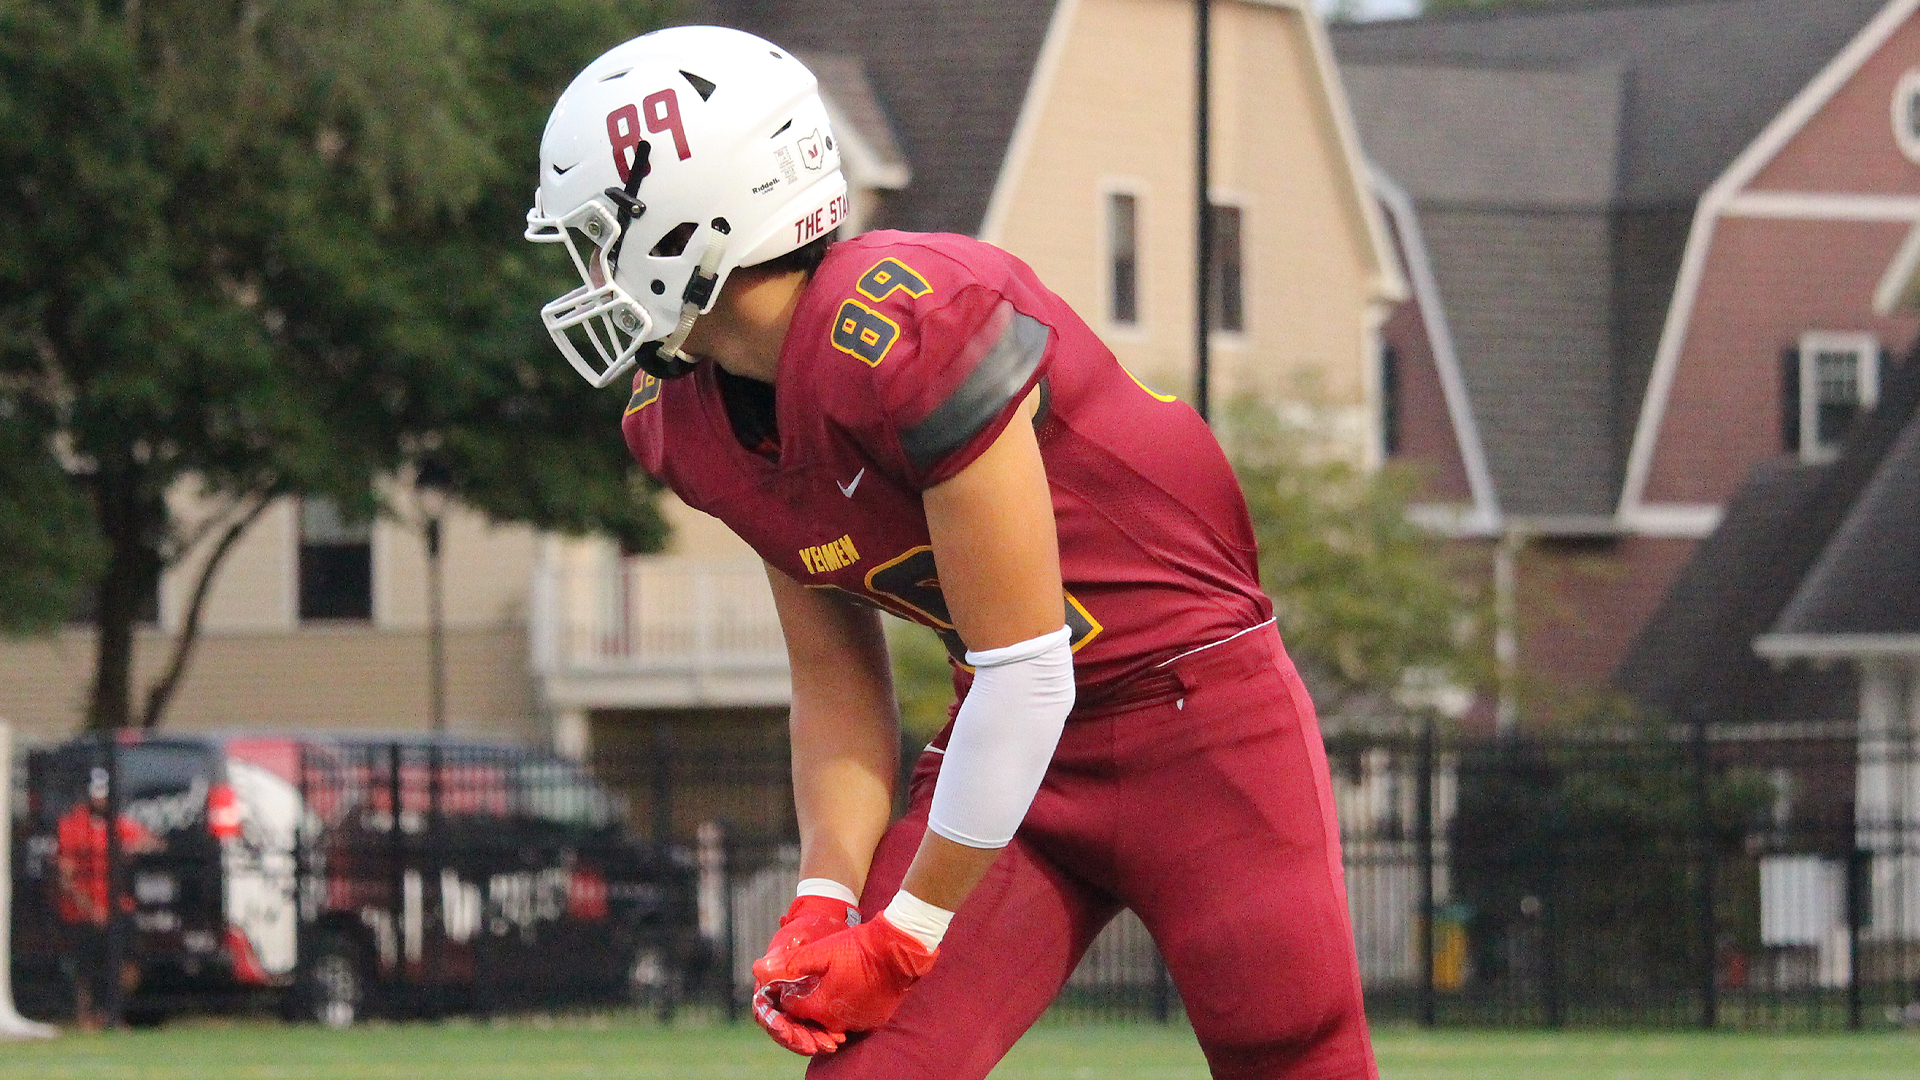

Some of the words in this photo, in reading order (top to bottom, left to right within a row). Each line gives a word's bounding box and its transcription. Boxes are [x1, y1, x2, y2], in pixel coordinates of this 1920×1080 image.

[606, 88, 692, 185] 89
[795, 207, 824, 244] THE
[829, 193, 850, 225] STA
[830, 257, 934, 368] 89
